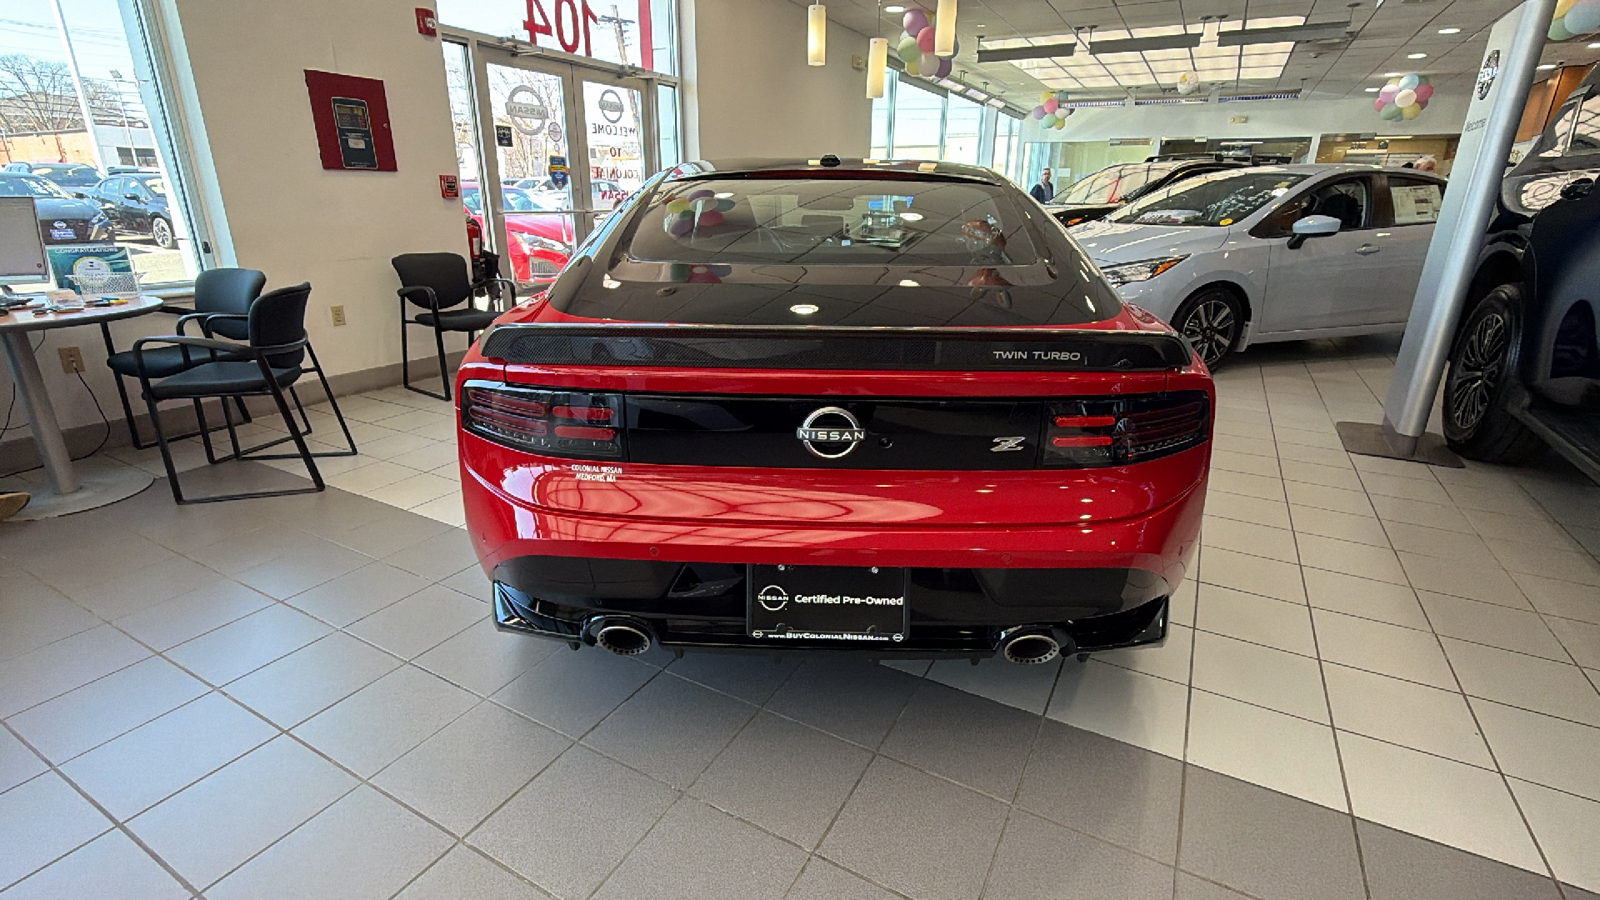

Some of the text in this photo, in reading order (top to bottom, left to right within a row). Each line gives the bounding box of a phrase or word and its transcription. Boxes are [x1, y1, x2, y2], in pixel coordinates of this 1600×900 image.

[992, 351, 1081, 361] TWIN TURBO
[798, 429, 865, 441] NISSAN
[571, 464, 623, 474] COLONIAL NISSAN
[794, 594, 904, 606] Certified Pre-Owned
